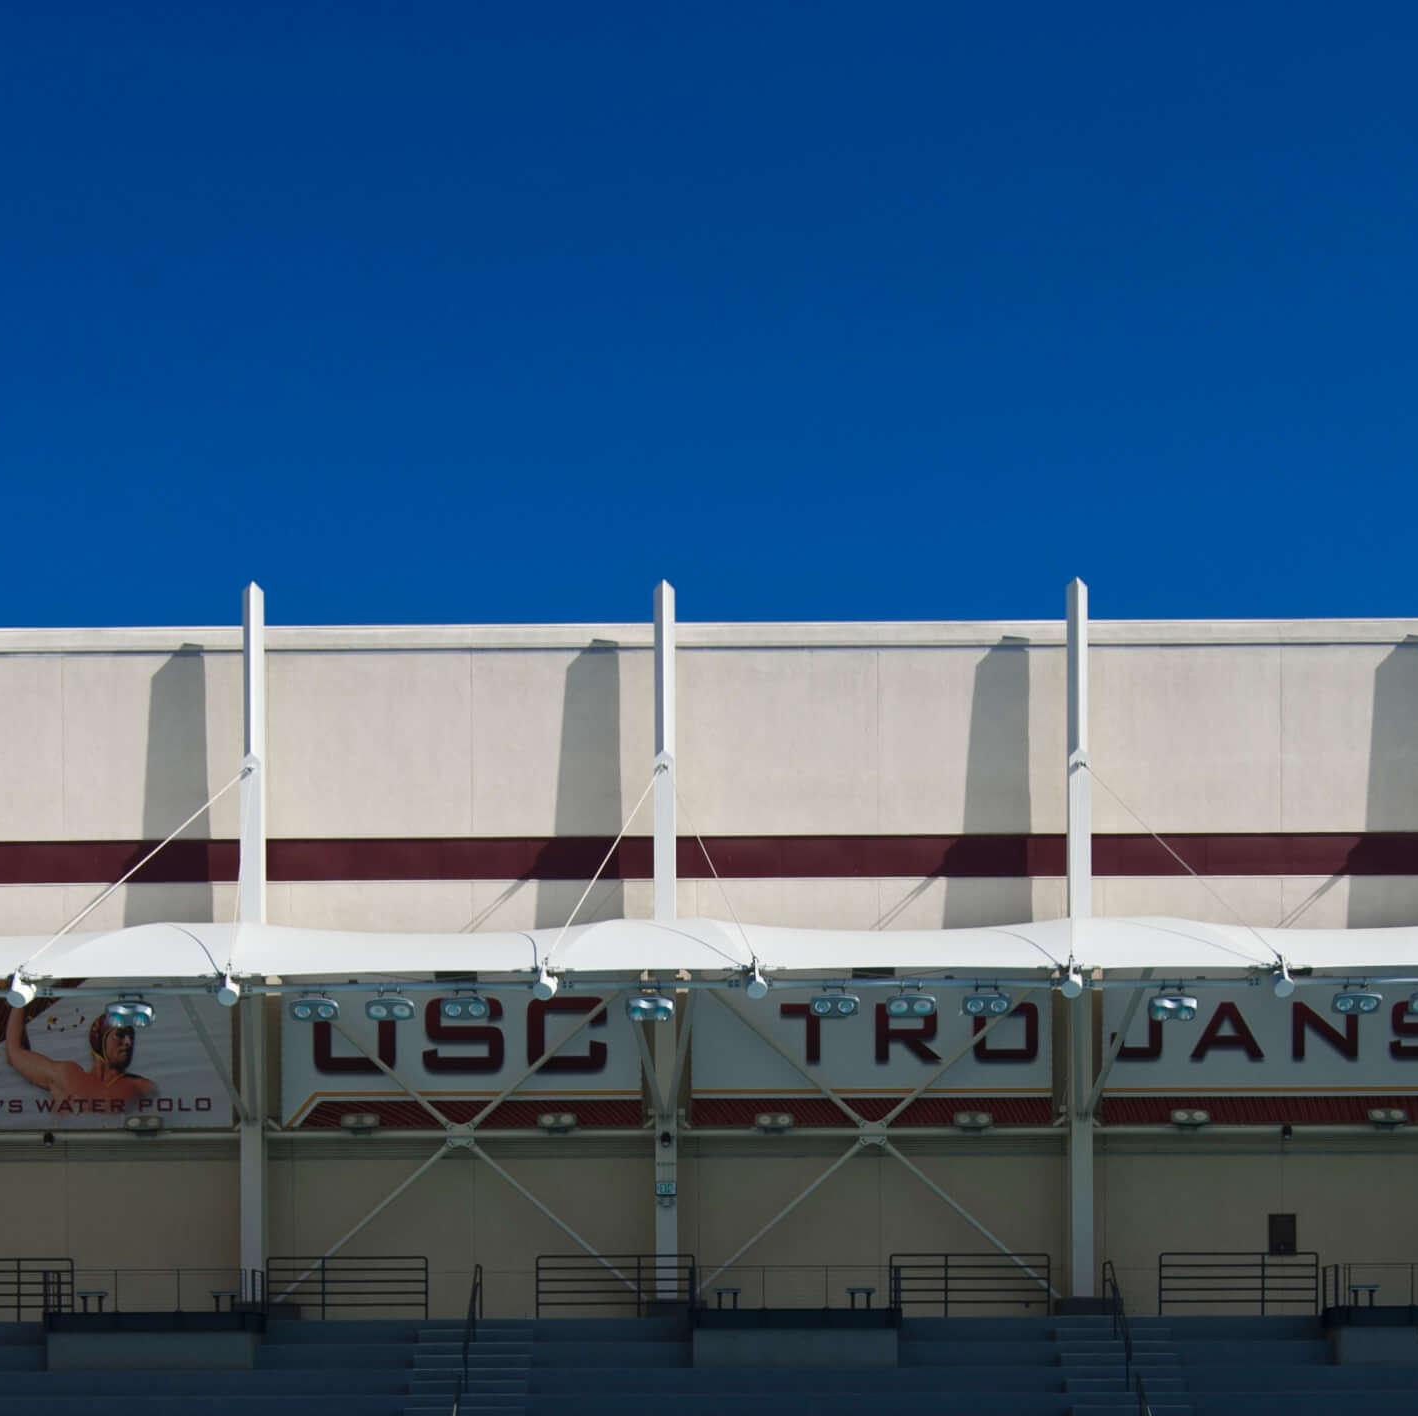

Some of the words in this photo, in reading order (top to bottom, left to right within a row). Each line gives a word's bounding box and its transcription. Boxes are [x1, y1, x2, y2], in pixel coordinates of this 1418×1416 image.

[313, 997, 607, 1075] USC
[35, 1099, 126, 1113] WATER
[138, 1097, 211, 1112] POLO
